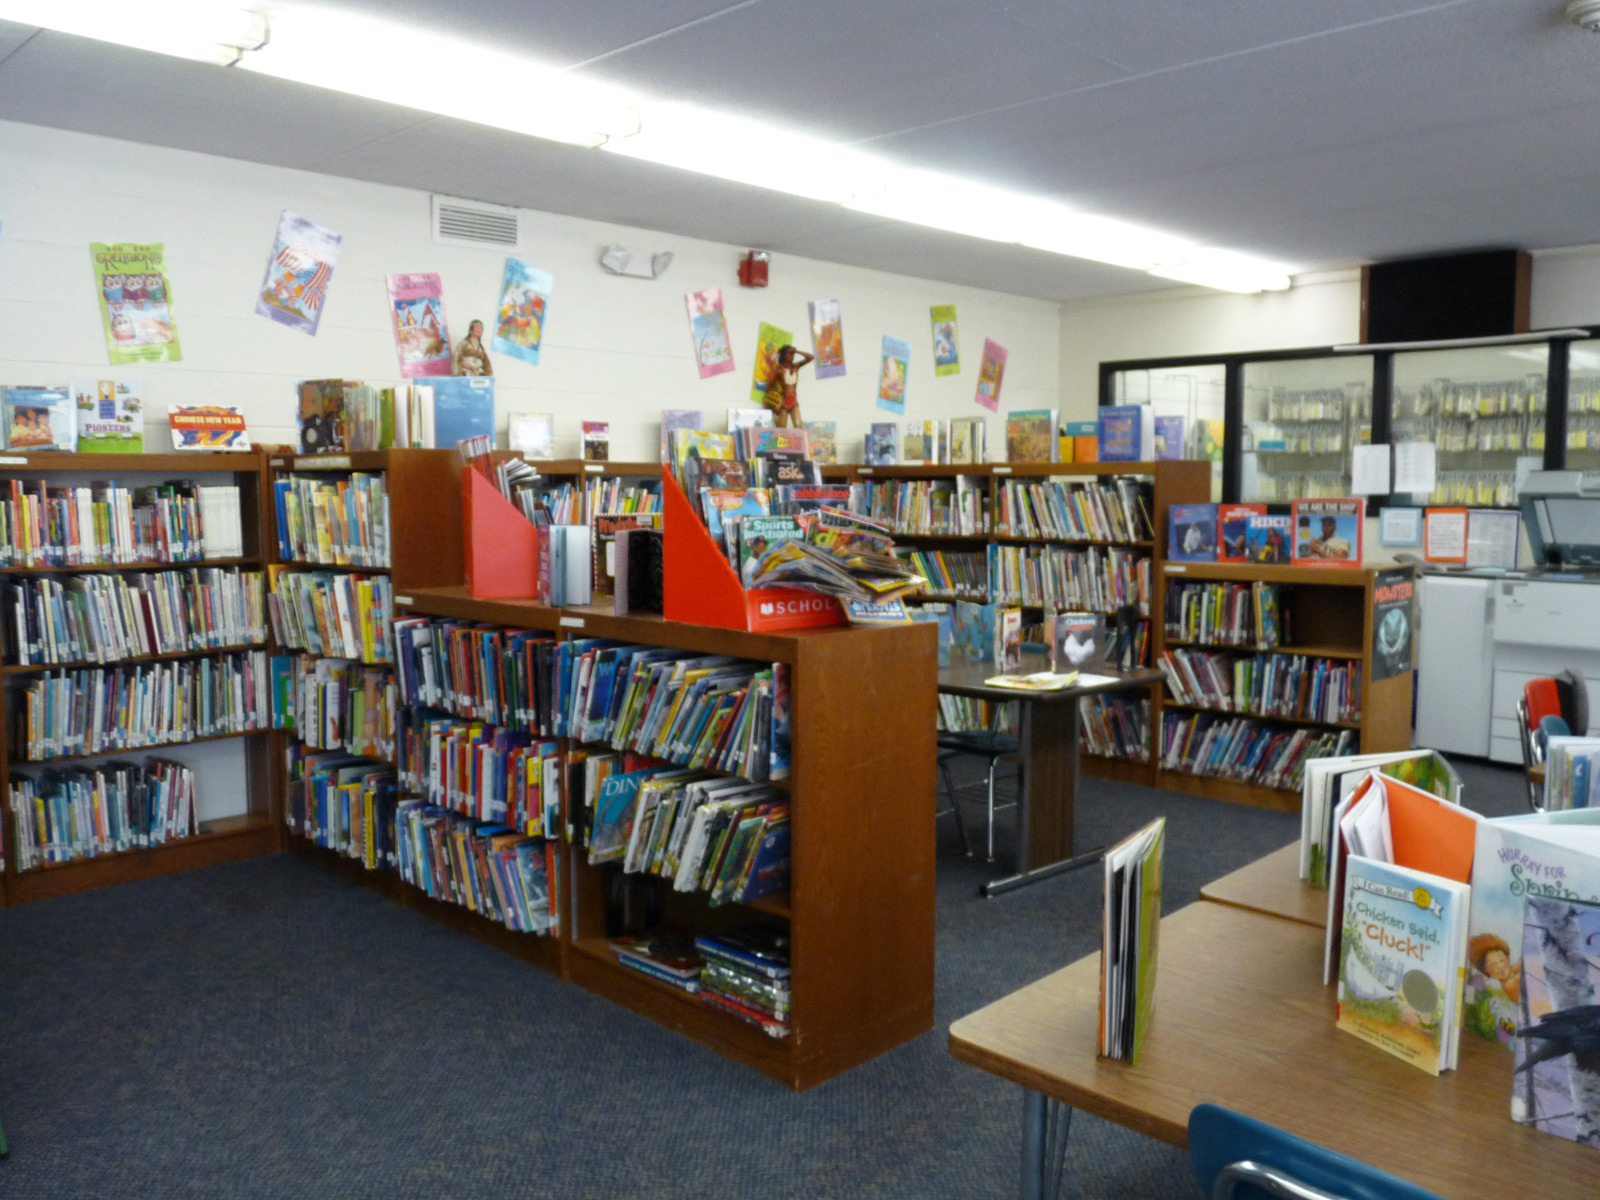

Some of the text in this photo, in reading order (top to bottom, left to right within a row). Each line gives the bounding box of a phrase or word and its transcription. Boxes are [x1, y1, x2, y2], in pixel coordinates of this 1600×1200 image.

[85, 423, 131, 433] PIONEERS
[174, 415, 242, 425] CHINESE NEW YEAR
[1299, 503, 1357, 512] WE ARE THE SHIP
[753, 520, 795, 531] Sports
[744, 528, 804, 541] Illustrated
[776, 598, 839, 615] SCHOL
[605, 777, 641, 796] DIN
[1497, 847, 1566, 879] HURRAY FOR
[1510, 863, 1598, 900] Sprin
[1368, 882, 1385, 893] Can
[1387, 886, 1410, 899] Read!
[1356, 902, 1440, 945] Chicken Said,
